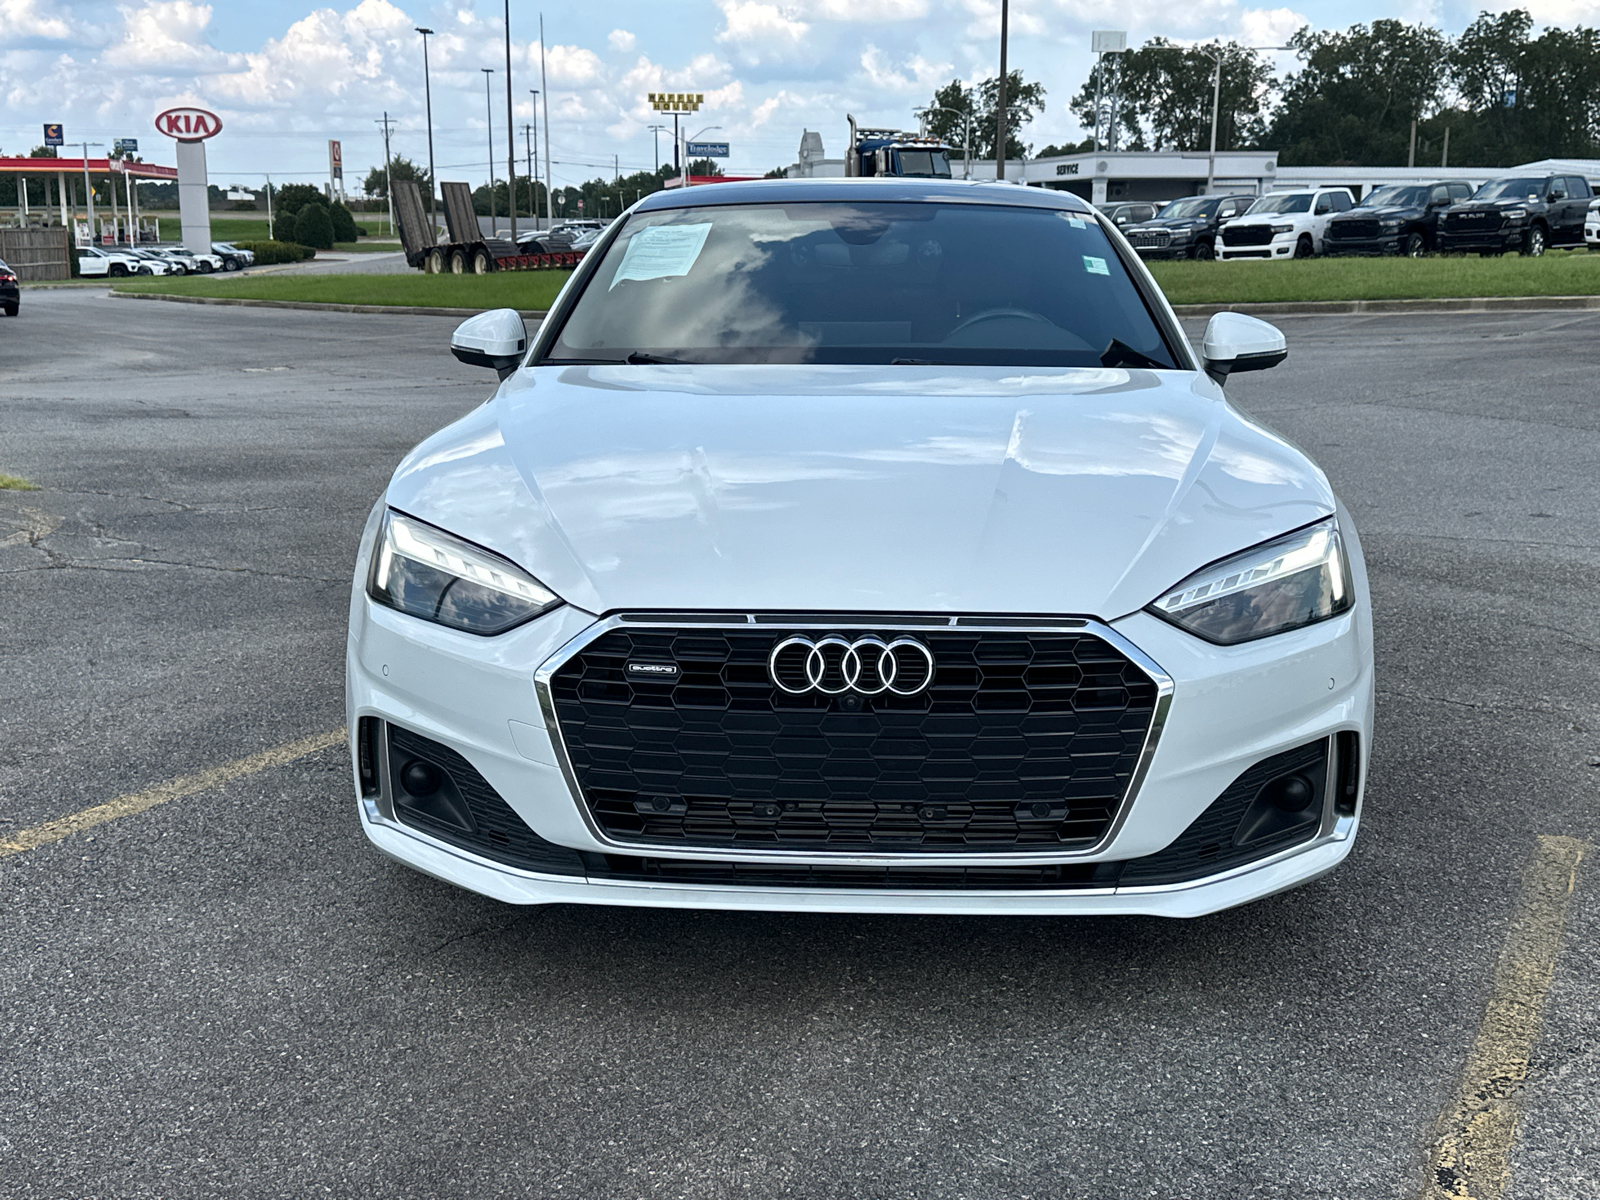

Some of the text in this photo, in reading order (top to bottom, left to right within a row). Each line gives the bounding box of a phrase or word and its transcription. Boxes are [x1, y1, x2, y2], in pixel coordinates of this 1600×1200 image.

[648, 93, 703, 103] WAFFLE
[653, 103, 699, 111] HOUSE
[165, 115, 210, 133] KIA
[689, 145, 727, 153] Travelodge
[1056, 163, 1079, 176] SERVICE
